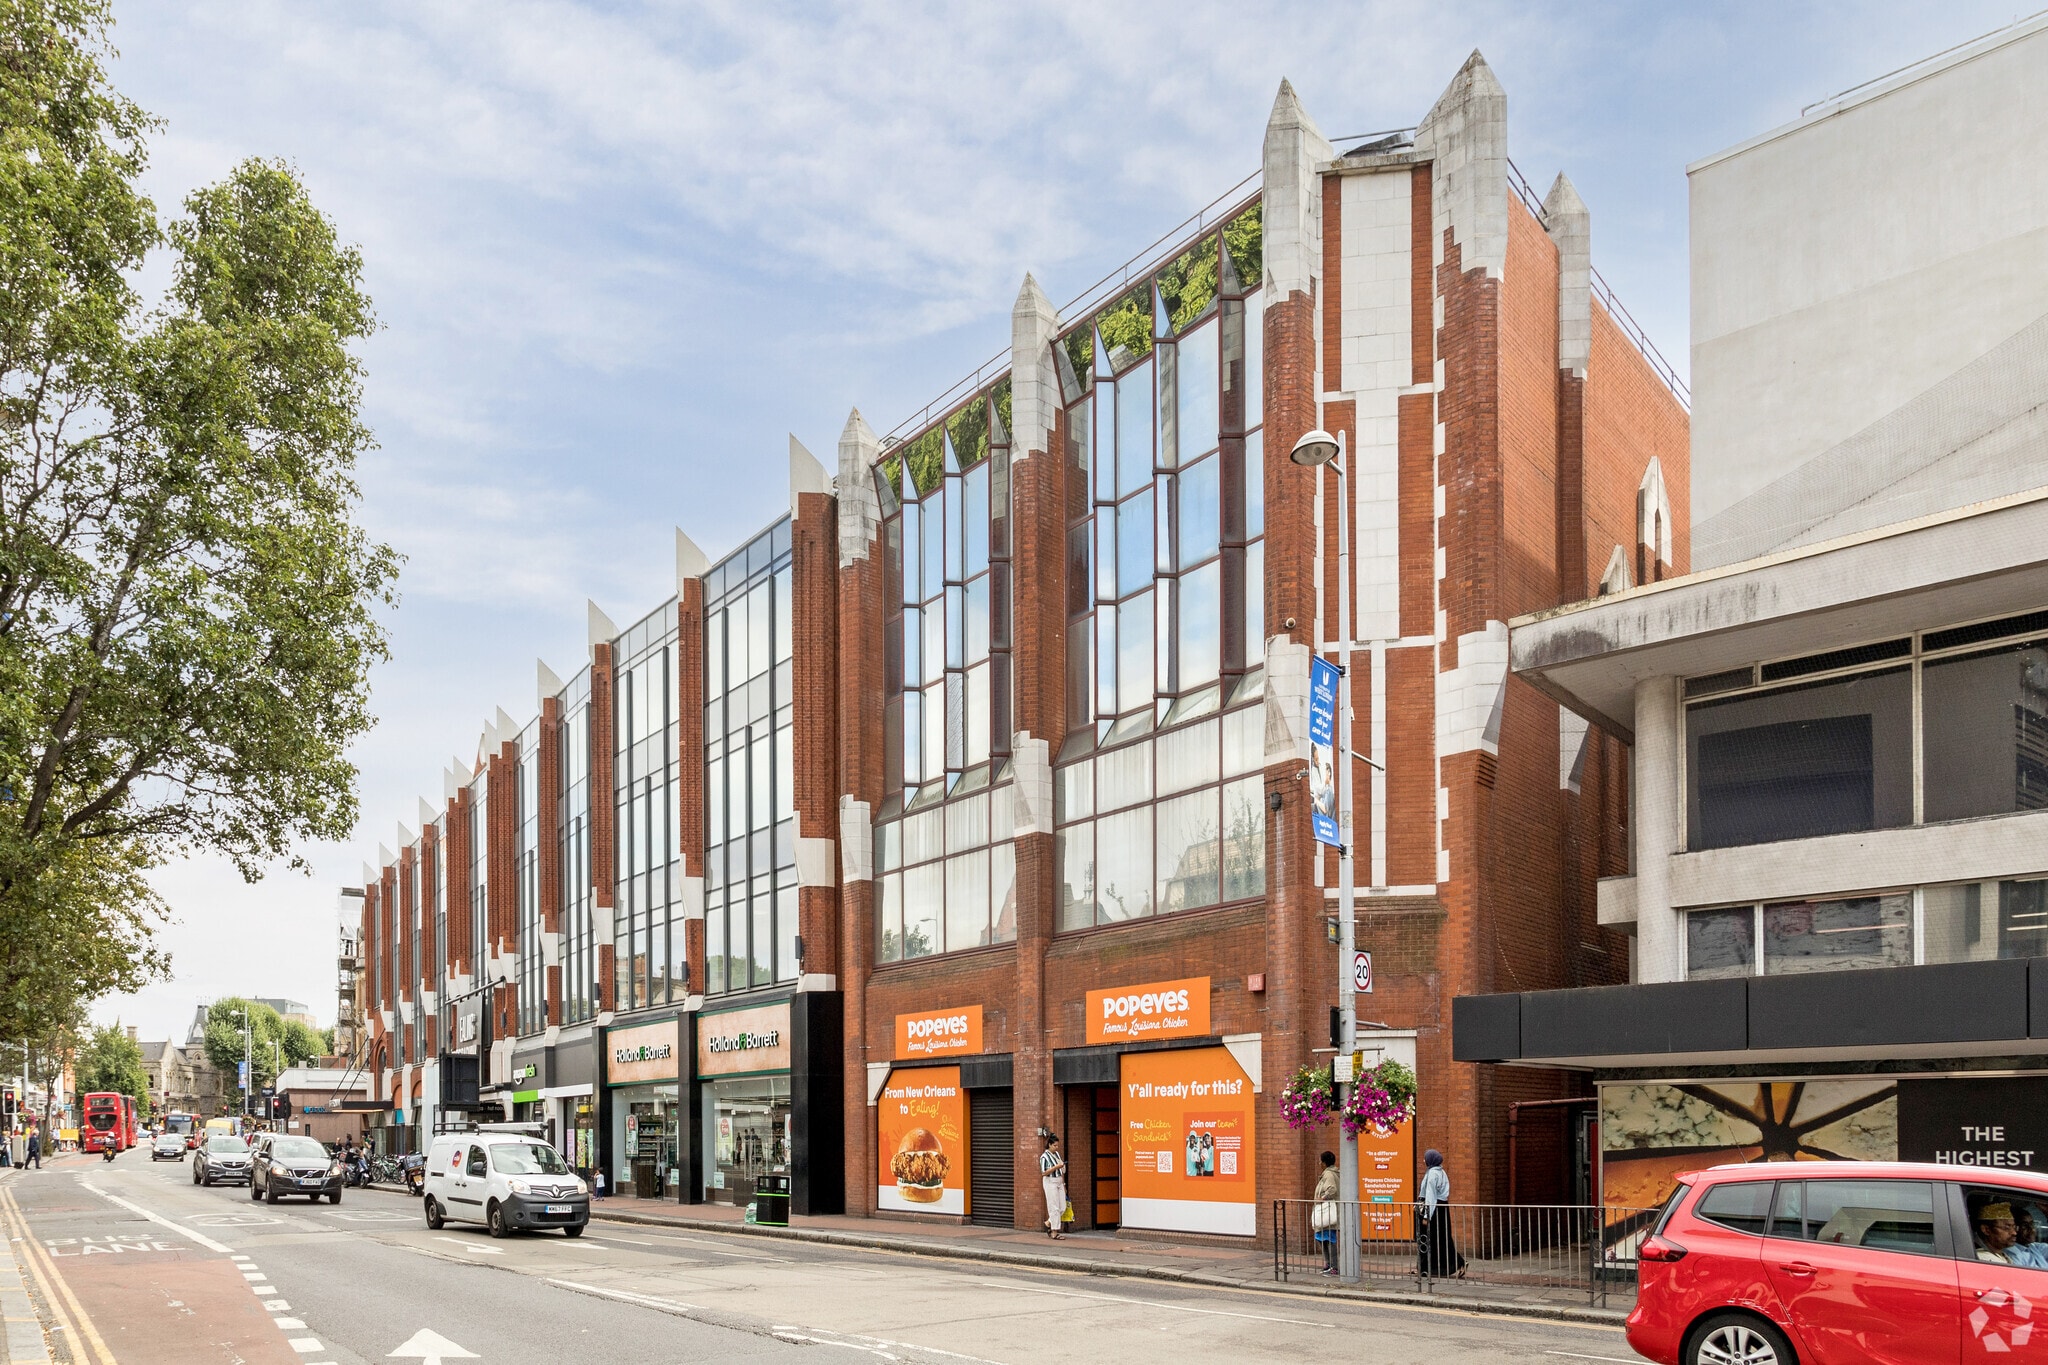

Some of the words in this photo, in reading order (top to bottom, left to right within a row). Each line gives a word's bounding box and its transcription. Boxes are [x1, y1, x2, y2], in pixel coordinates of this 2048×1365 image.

[1356, 964, 1368, 980] 20
[1102, 1022, 1128, 1035] Famous
[1128, 1018, 1161, 1036] Louisiana
[1162, 1016, 1188, 1028] Chicken
[709, 1033, 739, 1052] Holland
[747, 1030, 778, 1048] Barrett
[908, 1042, 925, 1052] Famous
[925, 1038, 948, 1053] Louisiana
[949, 1037, 967, 1047] Chicken
[616, 1047, 640, 1063] Holland
[645, 1044, 671, 1059] Barrett
[884, 1087, 904, 1098] From
[906, 1086, 923, 1097] New
[924, 1085, 956, 1097] Orleans
[1128, 1083, 1152, 1098] Y'all
[1154, 1081, 1188, 1099] ready
[1190, 1080, 1210, 1096] for
[1212, 1079, 1242, 1095] this?
[900, 1103, 908, 1114] to
[910, 1100, 940, 1118] Ealing!
[1144, 1119, 1171, 1130] Chicken
[1190, 1120, 1204, 1128] Join
[1961, 1126, 2004, 1141] THE
[1936, 1151, 2034, 1166] HIGHEST
[44, 1234, 154, 1245] BUS
[49, 1242, 194, 1257] LANE
